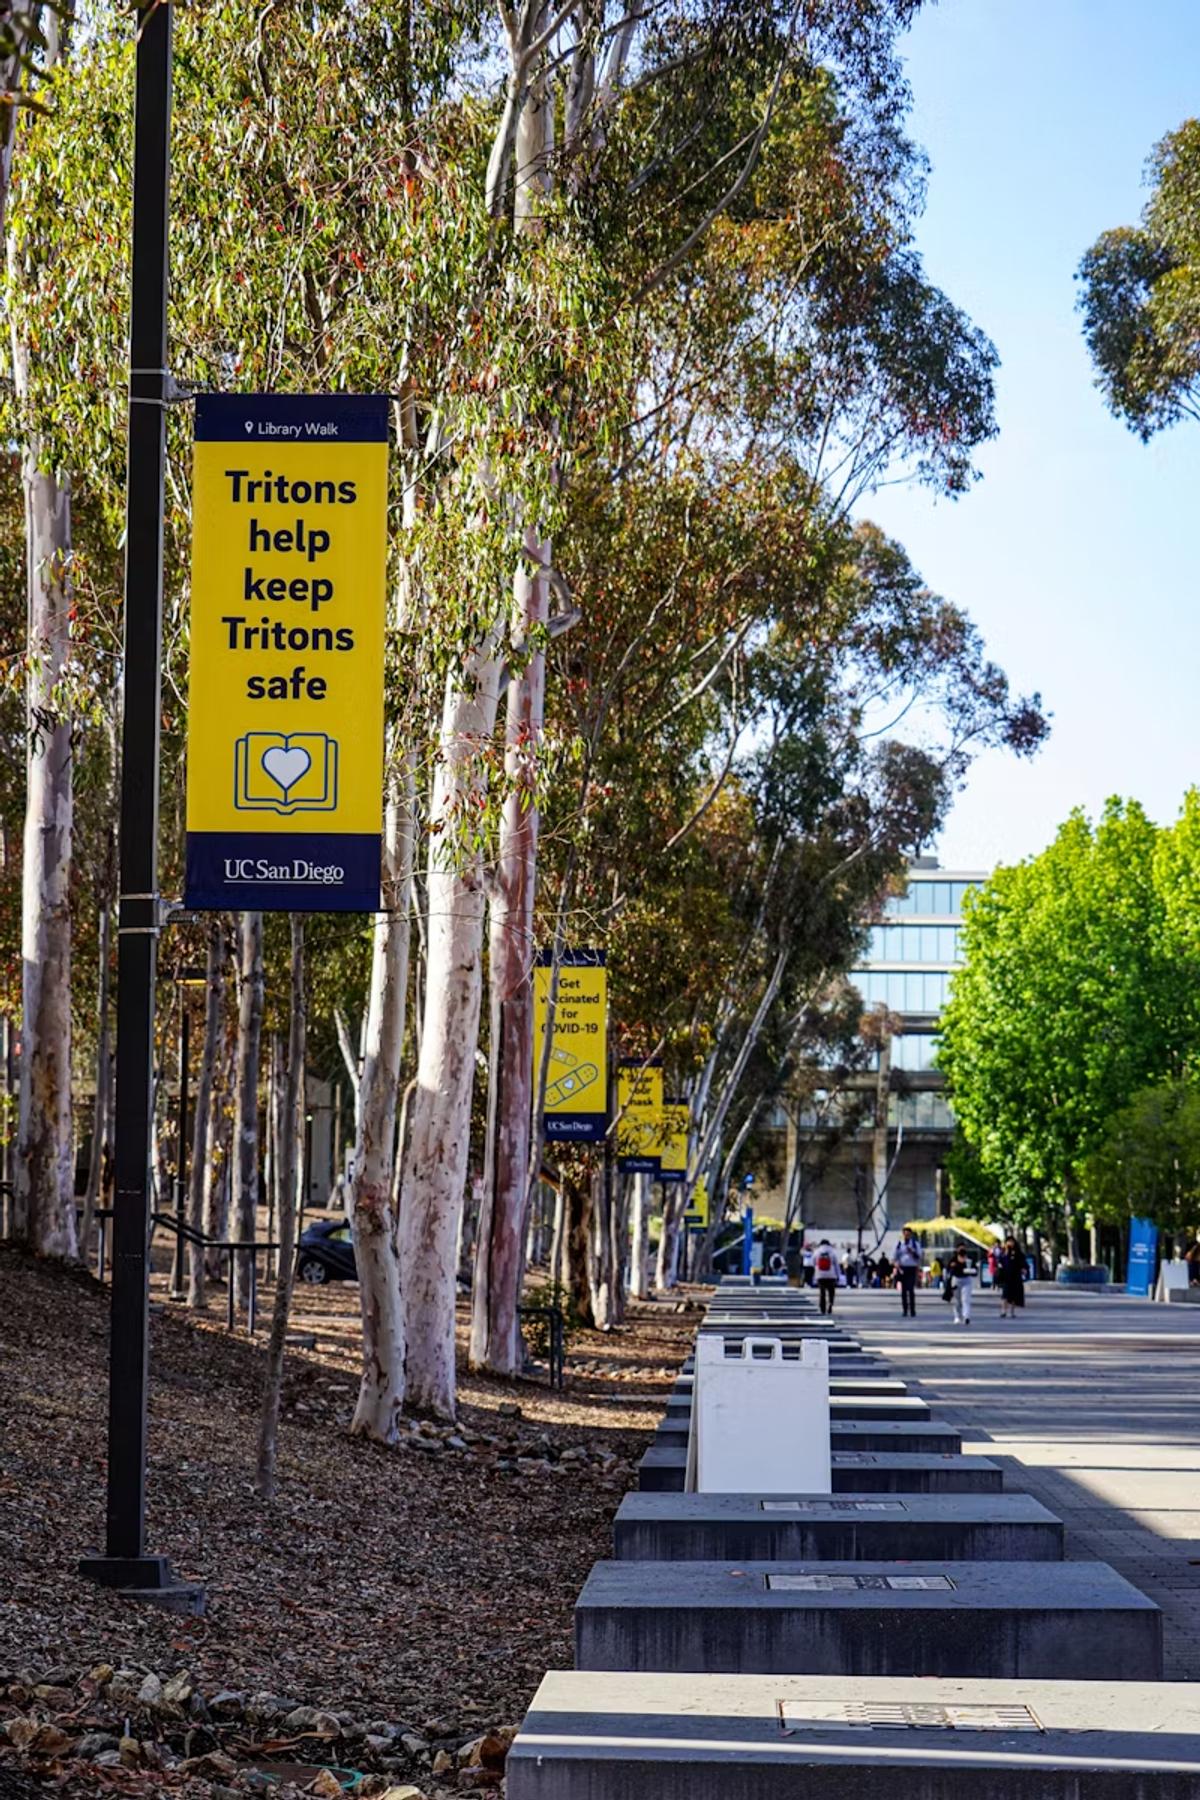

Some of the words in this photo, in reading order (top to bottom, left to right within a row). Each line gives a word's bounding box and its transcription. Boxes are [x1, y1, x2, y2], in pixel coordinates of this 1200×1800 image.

[258, 421, 302, 438] Library
[305, 422, 338, 435] Walk
[224, 470, 357, 504] Tritons
[249, 518, 331, 562] help
[244, 567, 334, 611] keep
[221, 617, 355, 651] Tritons
[246, 666, 327, 700] safe
[256, 859, 291, 880] San
[292, 859, 344, 885] Diego
[540, 993, 600, 1004] vcinated
[560, 978, 581, 989] Get
[561, 1008, 578, 1018] for
